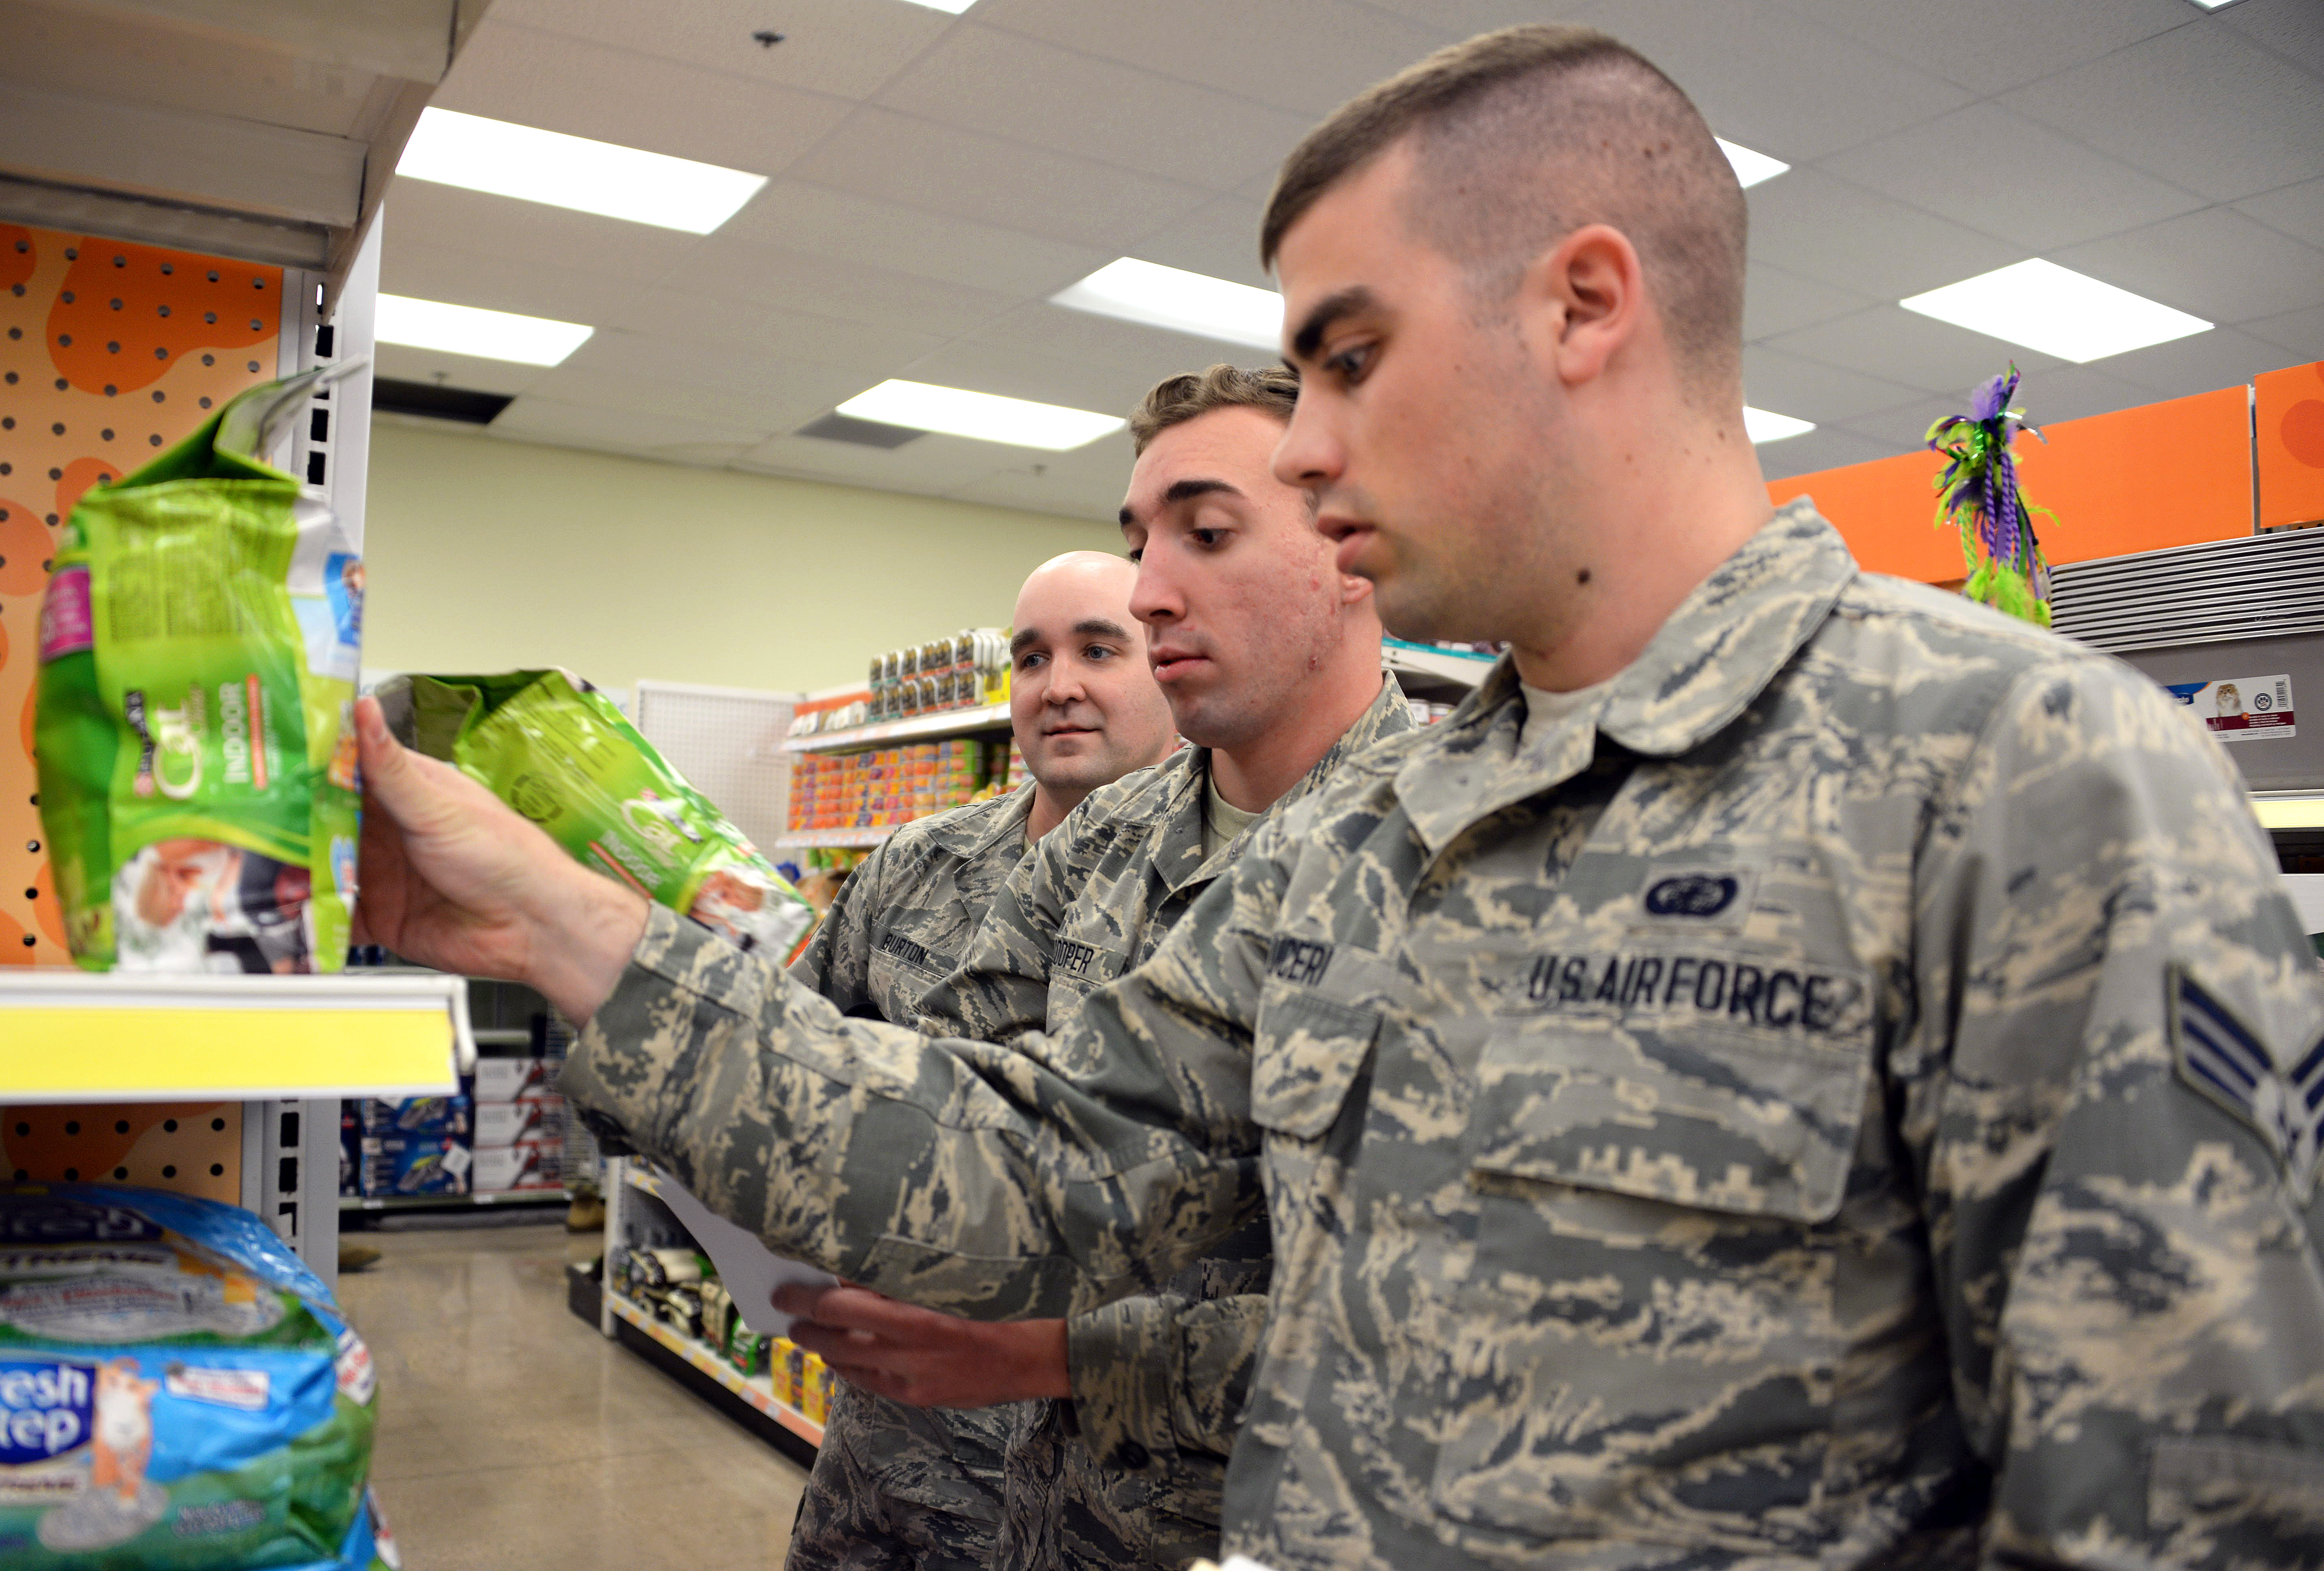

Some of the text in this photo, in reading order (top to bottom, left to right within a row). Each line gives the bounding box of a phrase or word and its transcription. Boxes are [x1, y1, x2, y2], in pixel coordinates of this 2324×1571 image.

[219, 682, 249, 784] INDOOR
[881, 933, 929, 965] BURTON
[1054, 939, 1094, 974] OOPER
[1594, 953, 1662, 1006] AIR
[1664, 956, 1833, 1031] FORCE
